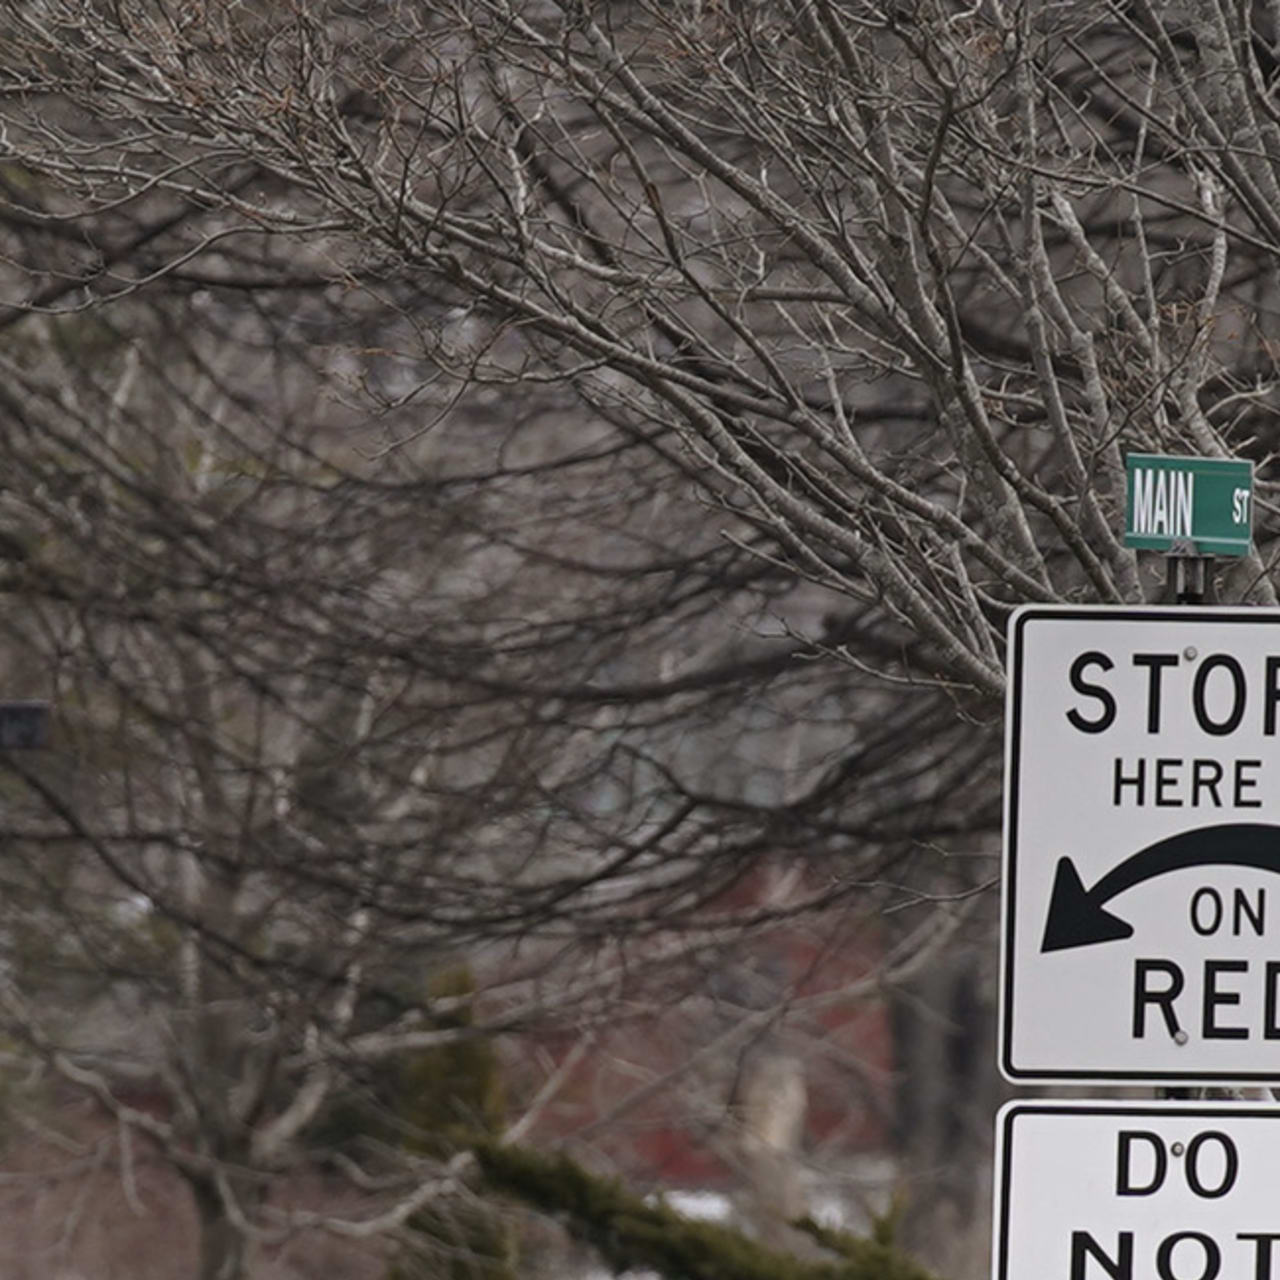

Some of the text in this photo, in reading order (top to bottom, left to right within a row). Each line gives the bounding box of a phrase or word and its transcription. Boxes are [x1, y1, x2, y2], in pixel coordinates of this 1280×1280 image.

[1133, 468, 1250, 537] MAIN ST
[1113, 757, 1263, 808] HERE
[1190, 886, 1267, 937] ON
[1116, 1129, 1240, 1200] DO
